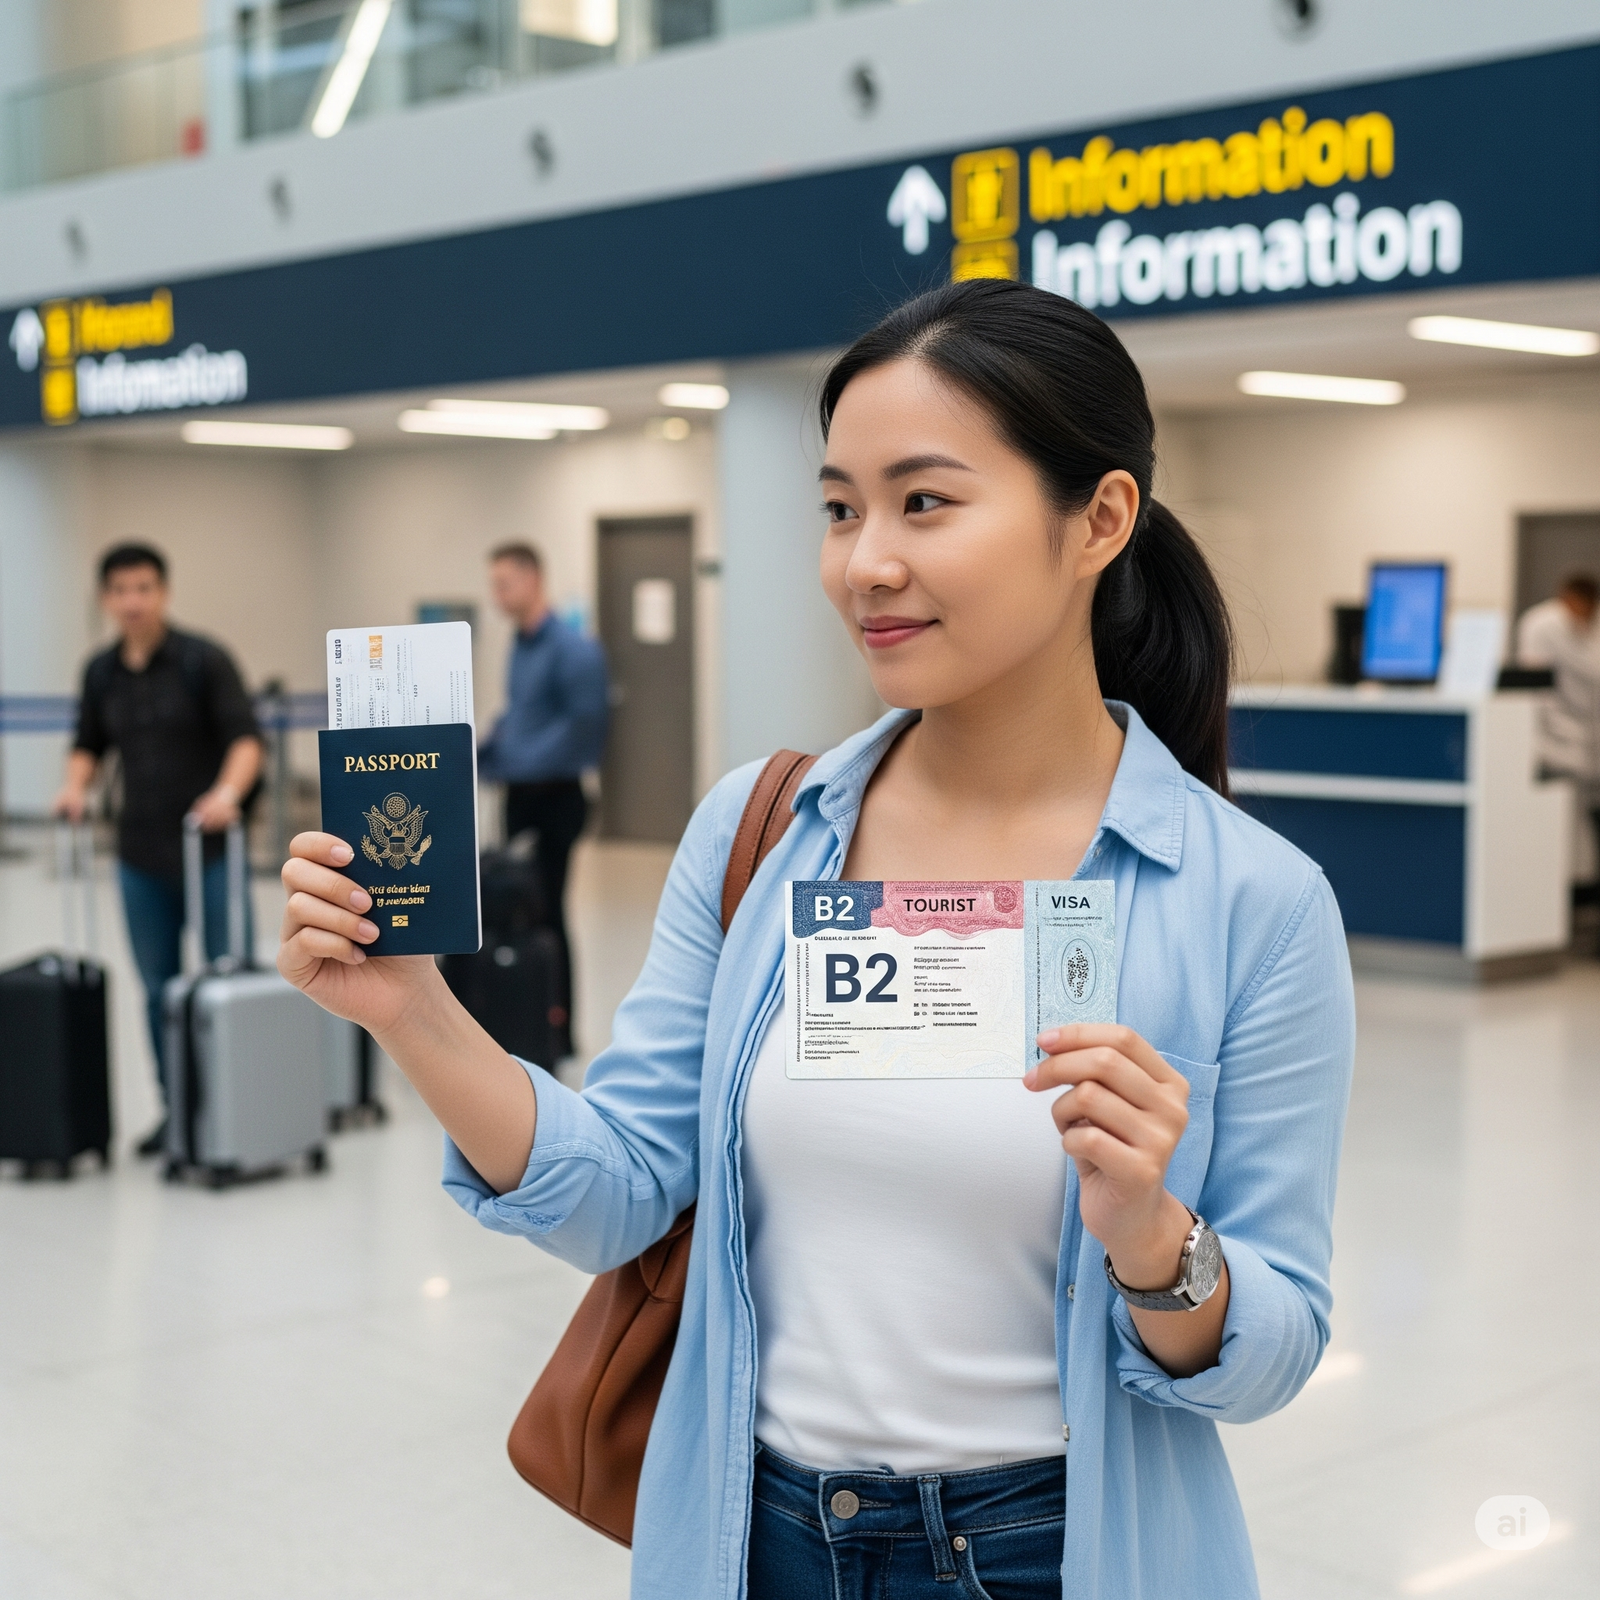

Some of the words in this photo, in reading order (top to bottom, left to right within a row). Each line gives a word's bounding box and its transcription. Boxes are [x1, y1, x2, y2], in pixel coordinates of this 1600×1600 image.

[1028, 106, 1395, 224] Information
[1032, 192, 1463, 308] Information
[344, 753, 440, 773] PASSPORT
[814, 895, 855, 921] B2
[903, 898, 976, 913] TOURIST
[1051, 895, 1091, 909] VISA
[825, 952, 898, 1004] B2
